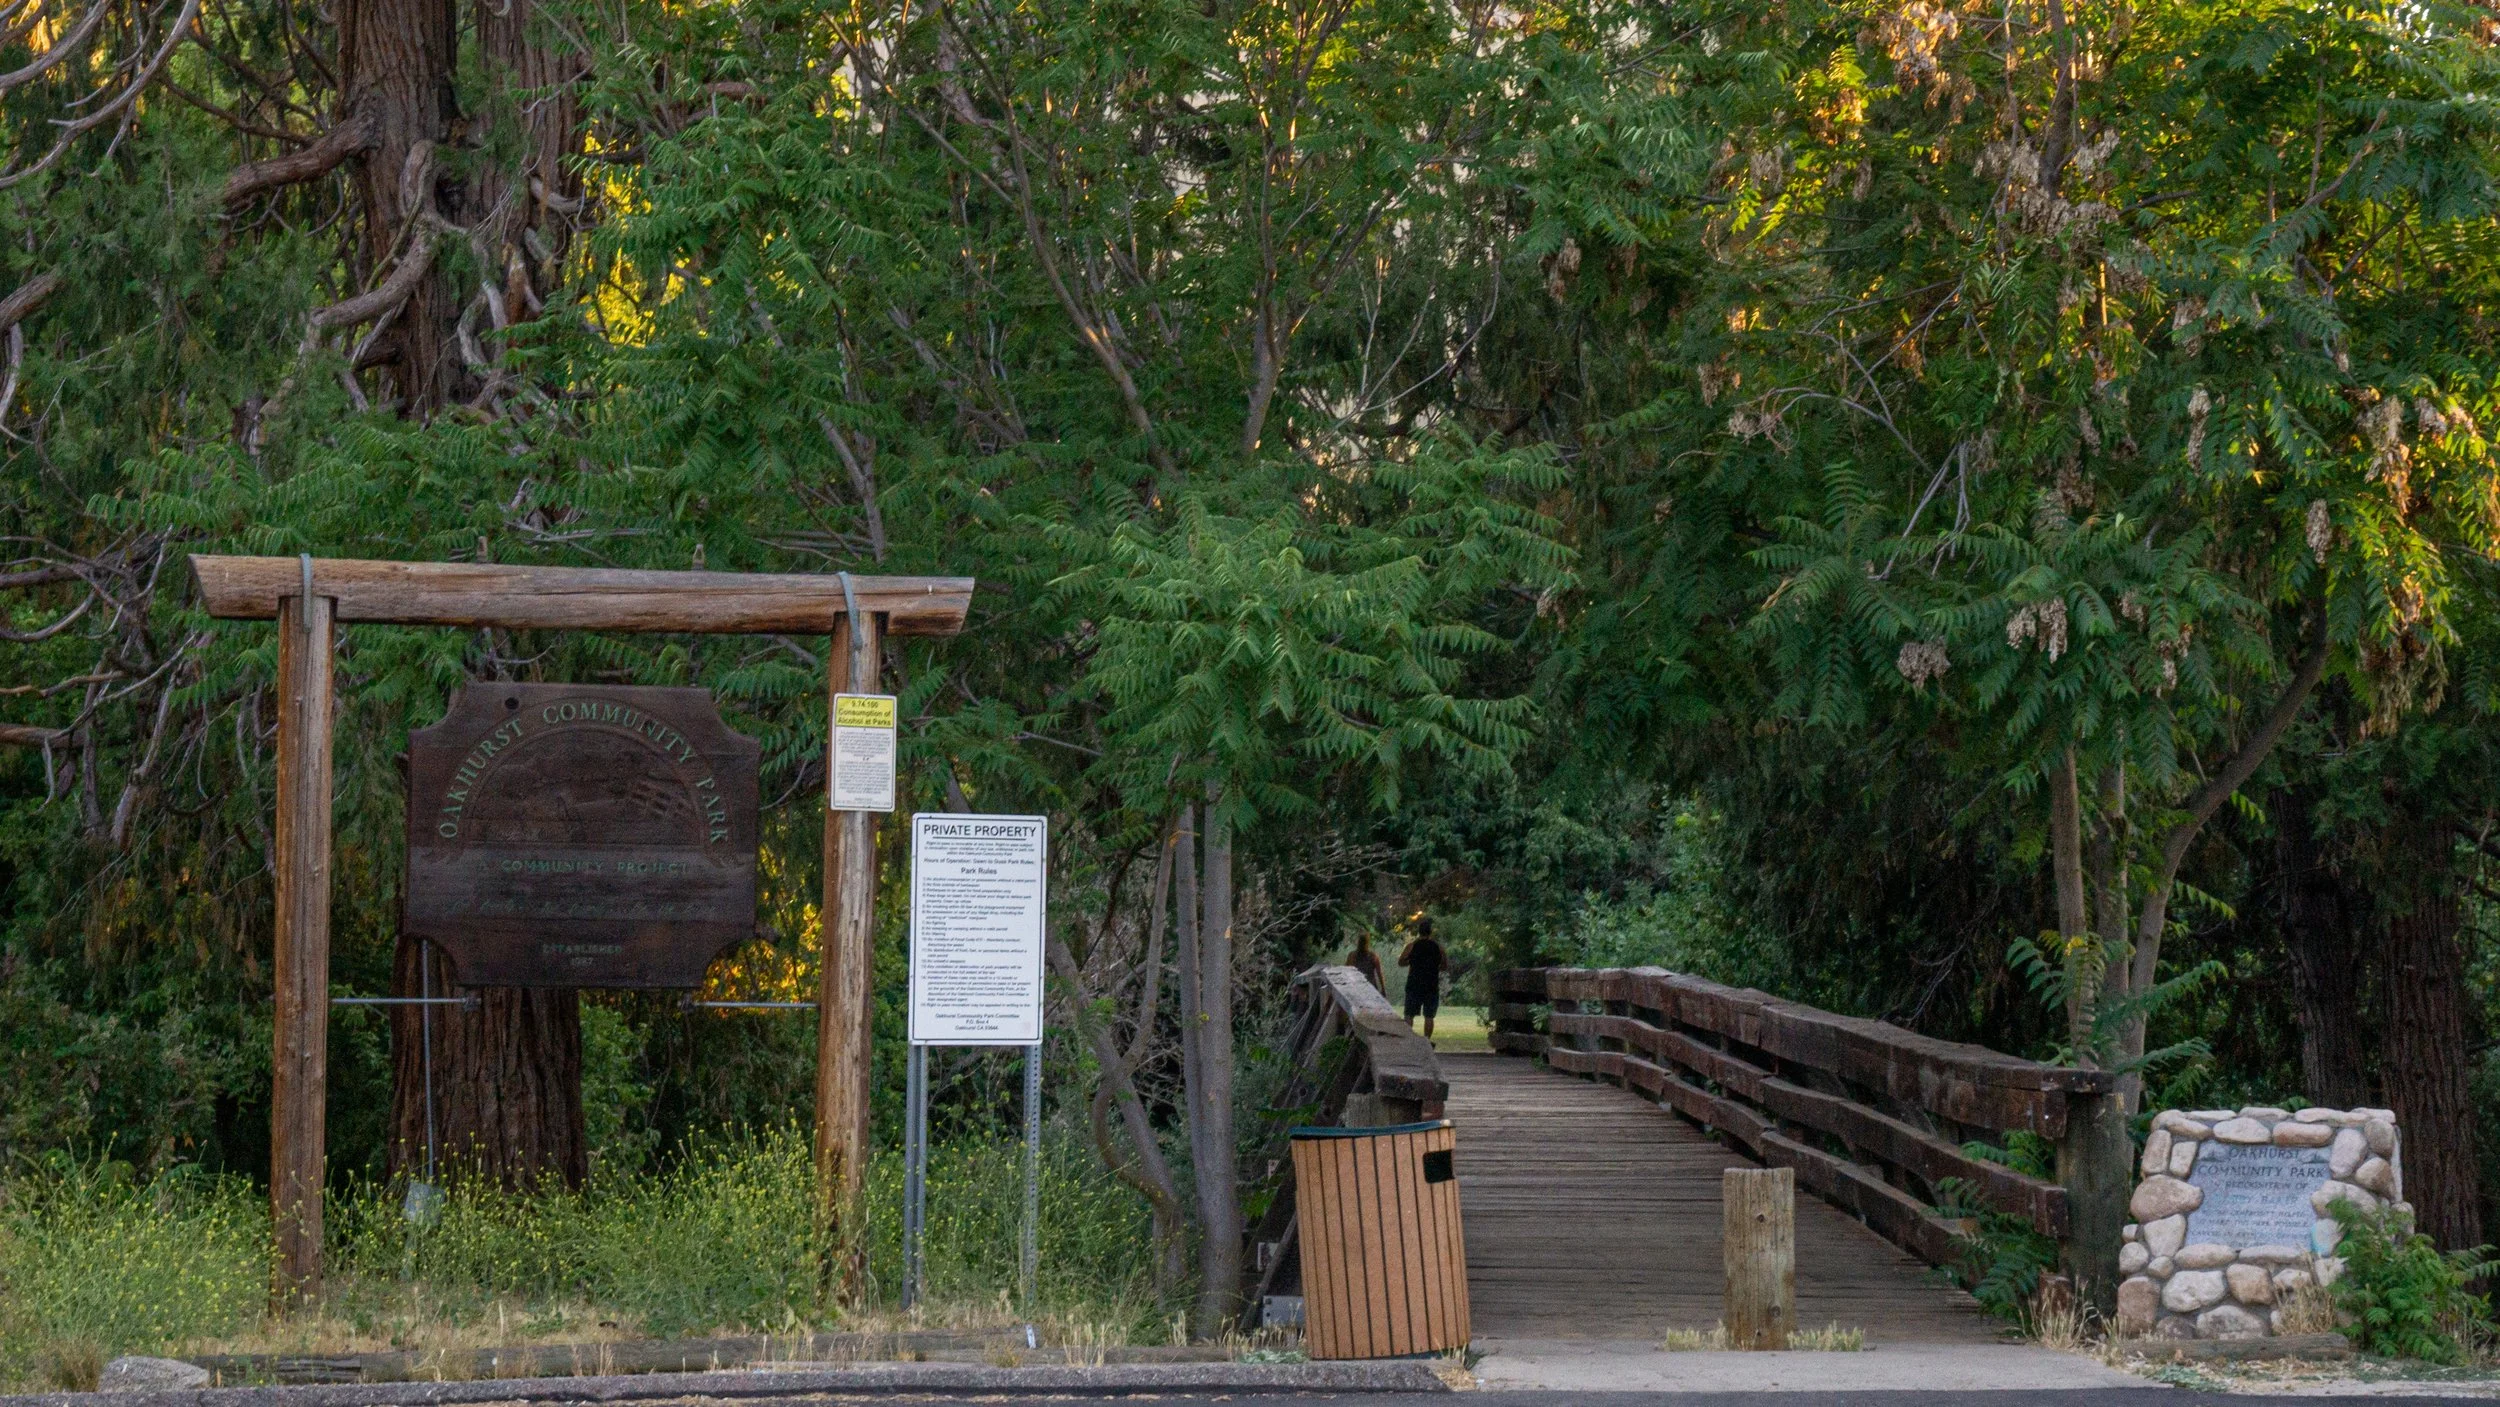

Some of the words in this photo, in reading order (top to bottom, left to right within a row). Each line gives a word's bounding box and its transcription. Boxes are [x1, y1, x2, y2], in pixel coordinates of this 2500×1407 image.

[838, 708, 882, 717] Consumption
[838, 716, 863, 725] Alcohol
[439, 718, 524, 838] OAKHURST
[543, 702, 697, 765] COMMUNITY
[695, 776, 729, 845] PARK
[924, 824, 971, 836] PRIVATE
[974, 825, 1037, 838] PROPERTY
[500, 860, 603, 873] COMMUNITY
[617, 861, 689, 874] PROJECT
[2228, 1147, 2301, 1160] OAKHURST
[2198, 1165, 2283, 1180] COMMUNITY
[2290, 1166, 2325, 1178] PARK
